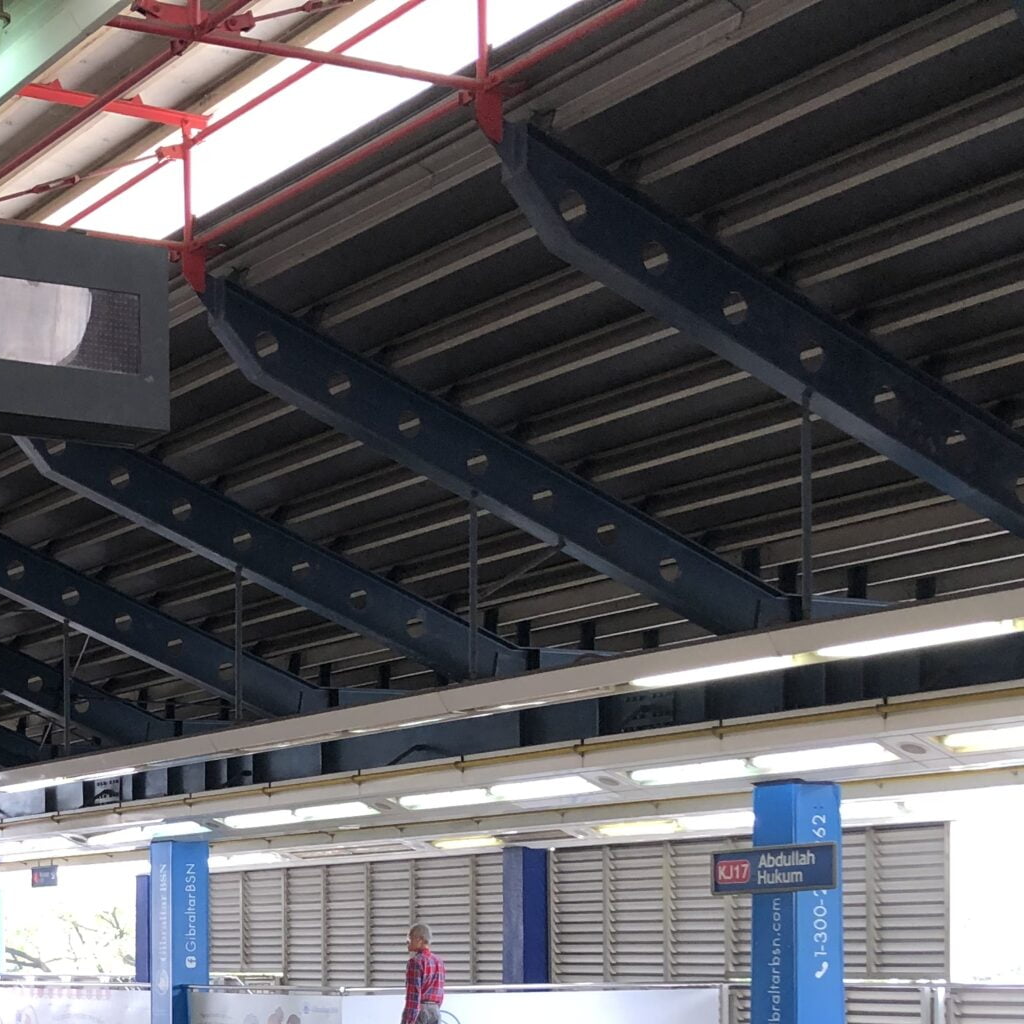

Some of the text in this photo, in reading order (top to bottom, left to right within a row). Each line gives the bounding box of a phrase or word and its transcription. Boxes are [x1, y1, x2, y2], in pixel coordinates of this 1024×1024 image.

[758, 850, 816, 869] Abdullah
[718, 863, 751, 881] KJ17
[757, 869, 803, 885] Hukum
